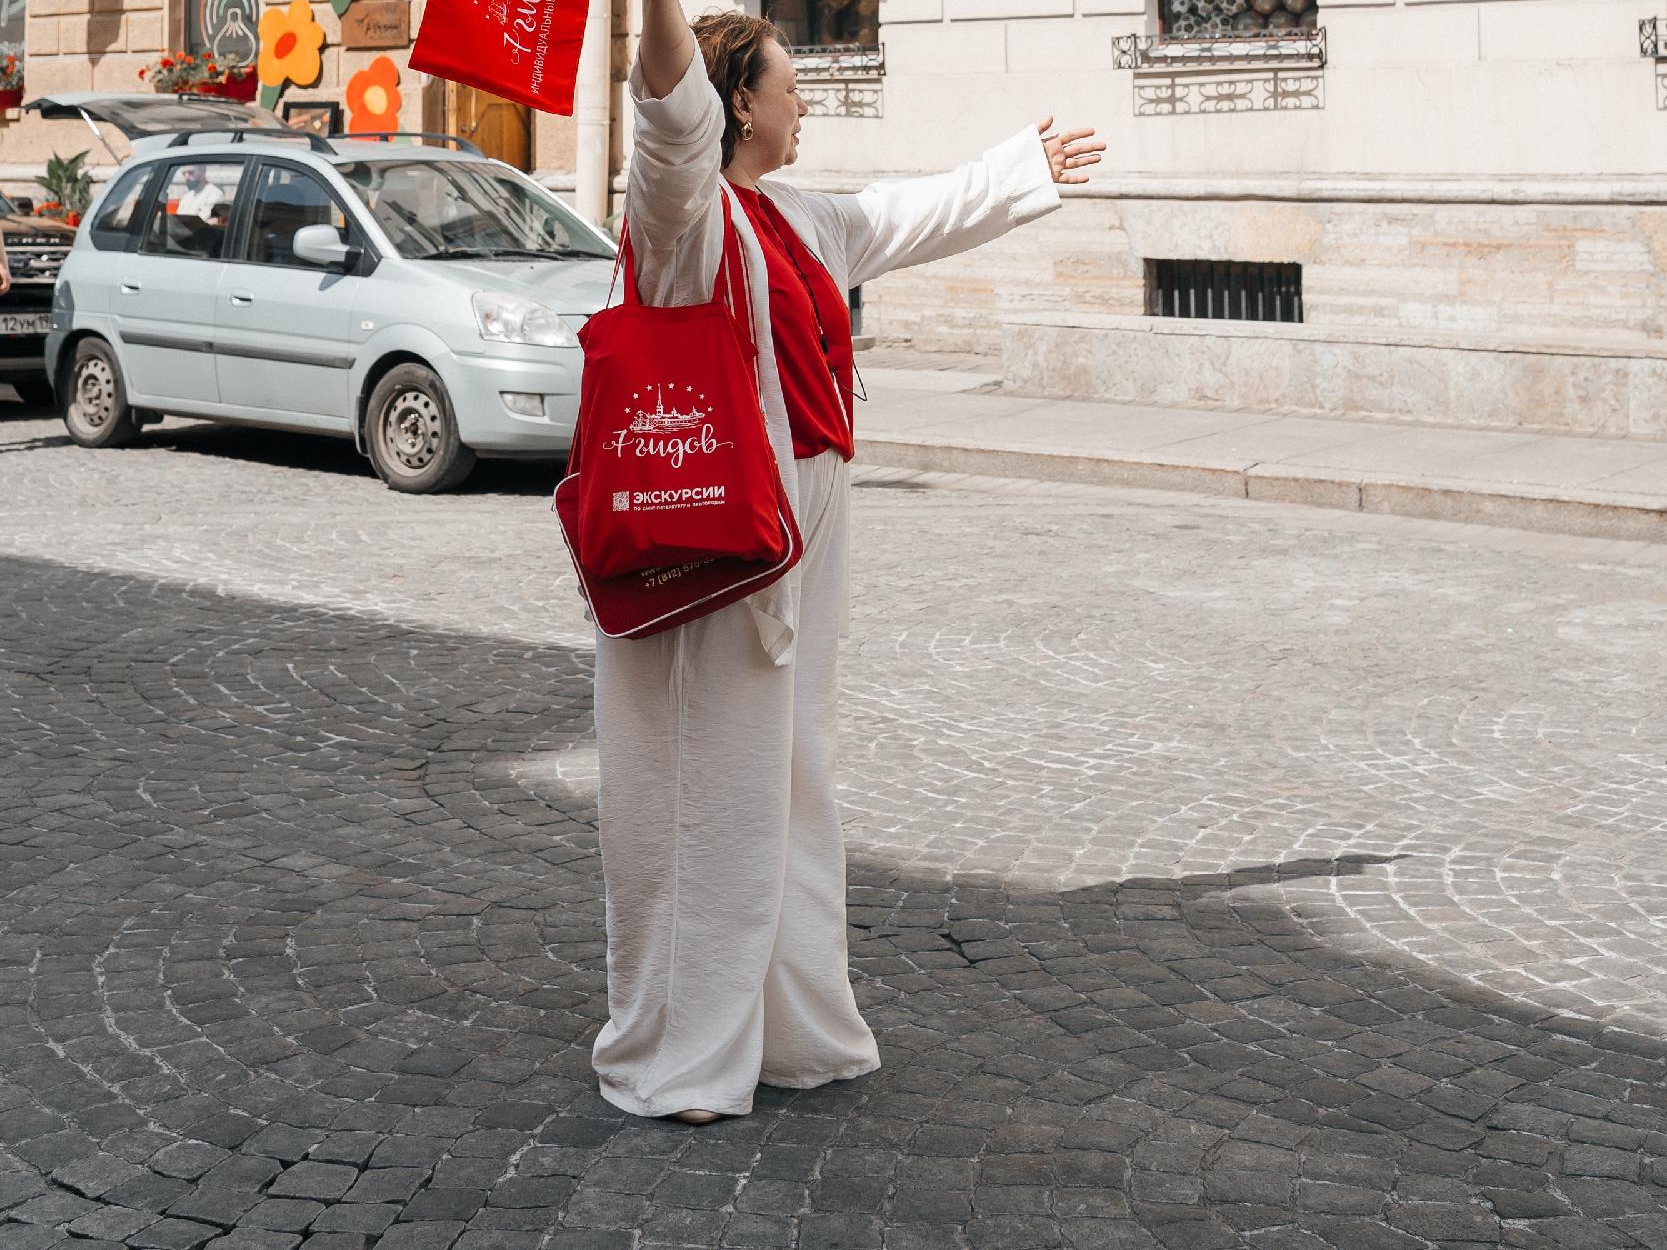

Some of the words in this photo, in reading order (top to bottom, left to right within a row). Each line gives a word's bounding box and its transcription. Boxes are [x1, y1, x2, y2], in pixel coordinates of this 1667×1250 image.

[503, 29, 532, 64] 7
[602, 428, 635, 458] 7
[635, 423, 734, 469] гидов
[633, 485, 725, 504] ЭКСКУРСИИ
